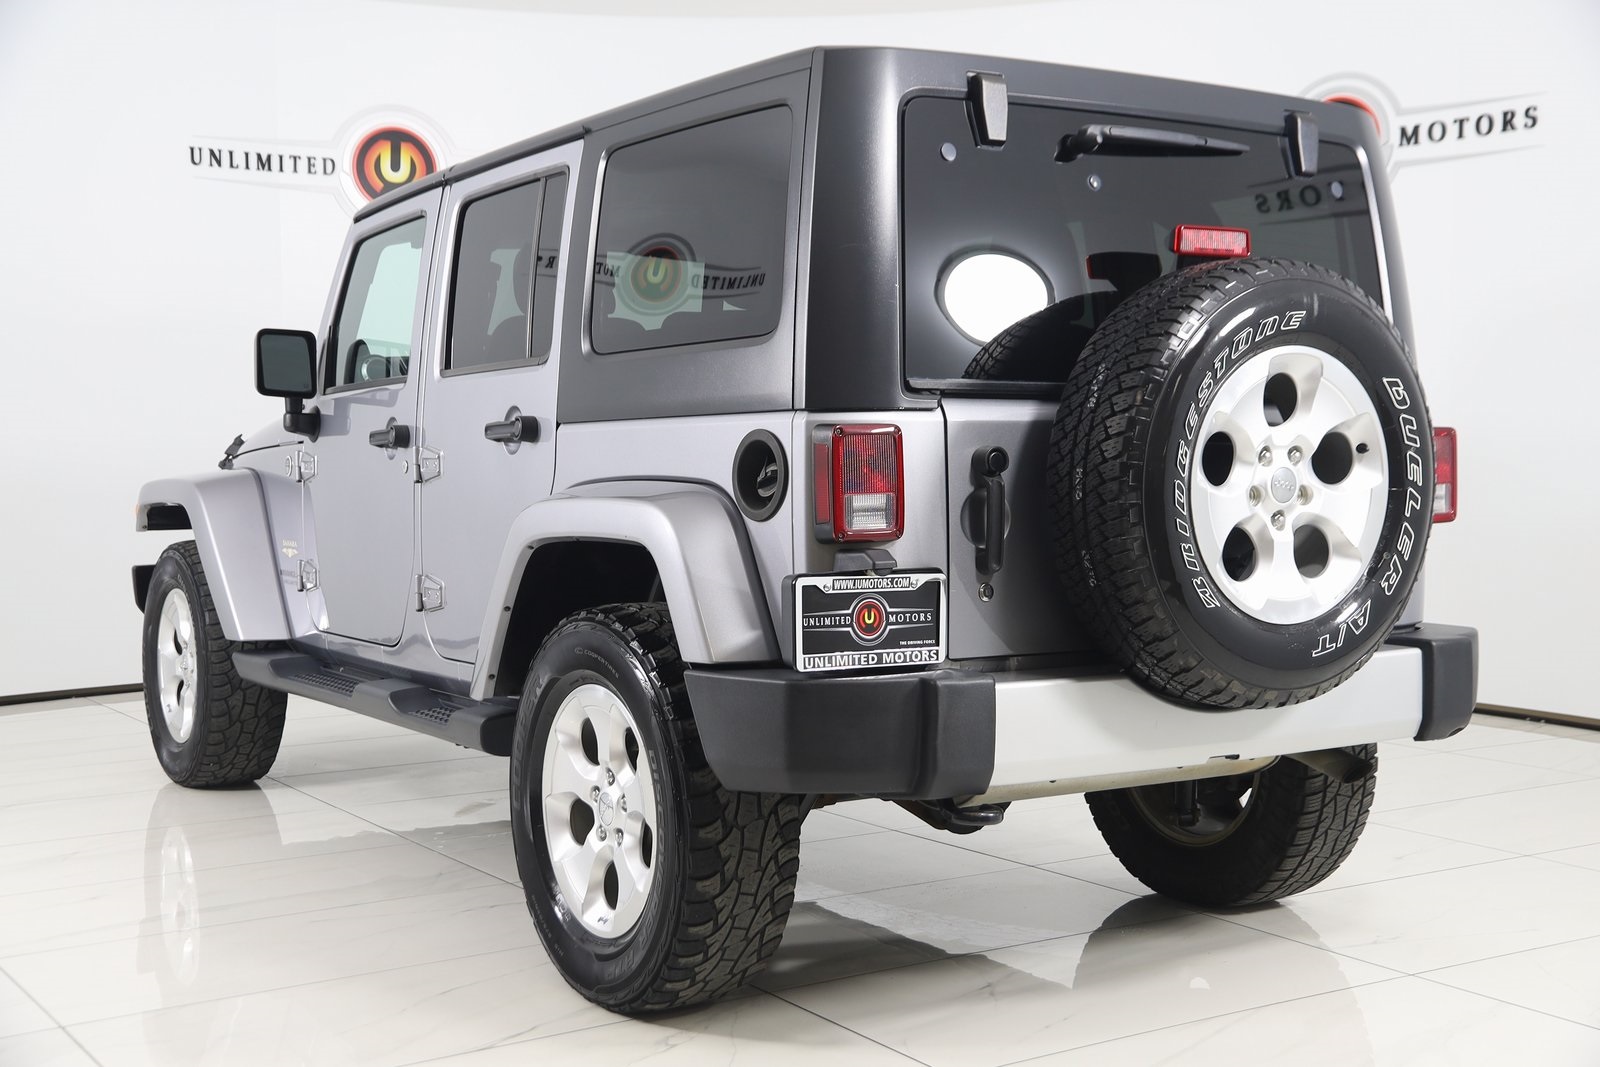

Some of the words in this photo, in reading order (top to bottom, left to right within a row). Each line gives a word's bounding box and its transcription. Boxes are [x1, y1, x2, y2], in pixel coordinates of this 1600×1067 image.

[1398, 105, 1539, 148] MOTORS
[189, 145, 336, 176] UNLIMITED
[1174, 311, 1306, 608] BRIDGESTONE
[1380, 376, 1423, 596] DUELER
[803, 615, 851, 627] UNLIMITED
[888, 612, 932, 623] MOTORS
[1312, 600, 1371, 657] A/T
[804, 653, 878, 669] UNLIMITED
[882, 649, 938, 665] MOTORS
